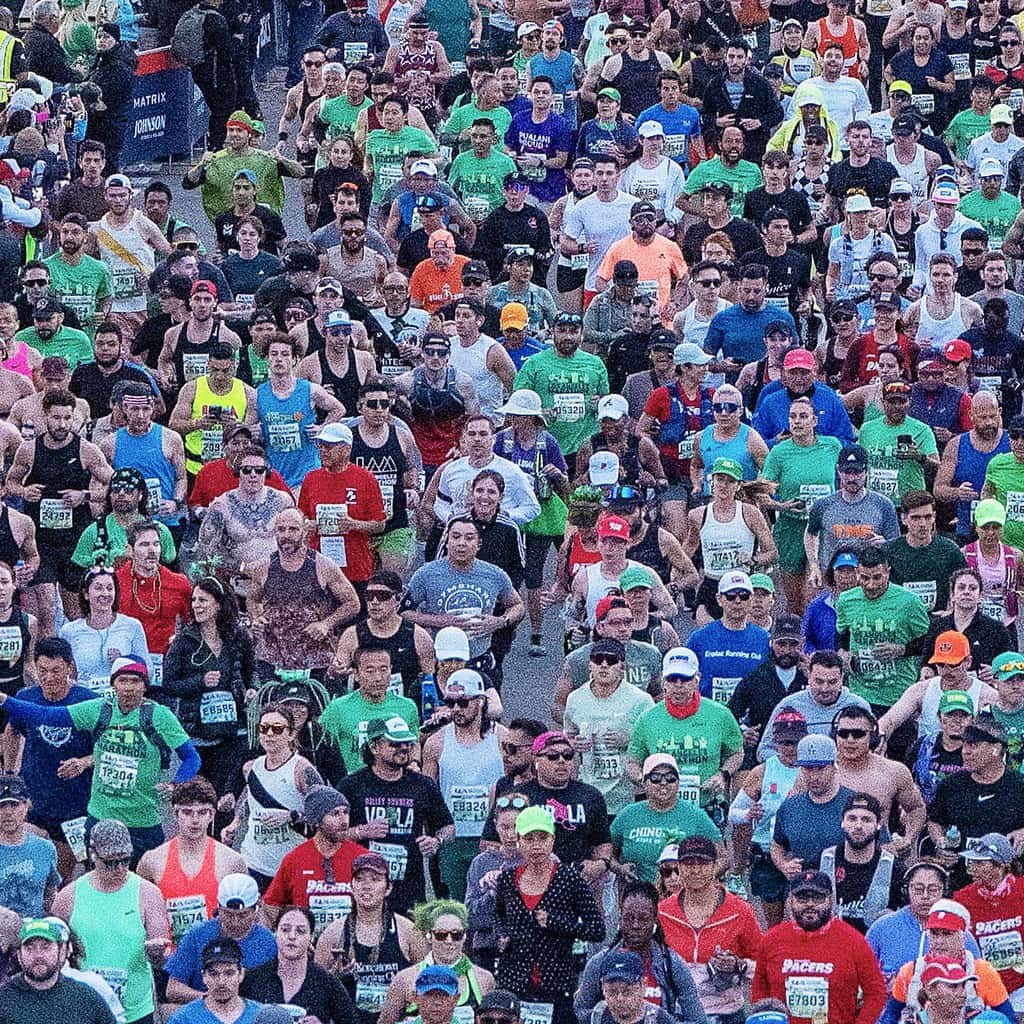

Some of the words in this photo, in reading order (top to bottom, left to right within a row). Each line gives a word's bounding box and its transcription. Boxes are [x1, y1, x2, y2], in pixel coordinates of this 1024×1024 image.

[133, 92, 167, 109] MATRIX
[133, 114, 167, 138] JOHNSON
[975, 916, 1022, 936] PACERS
[781, 959, 834, 974] PACERS
[787, 994, 824, 1007] E7803
